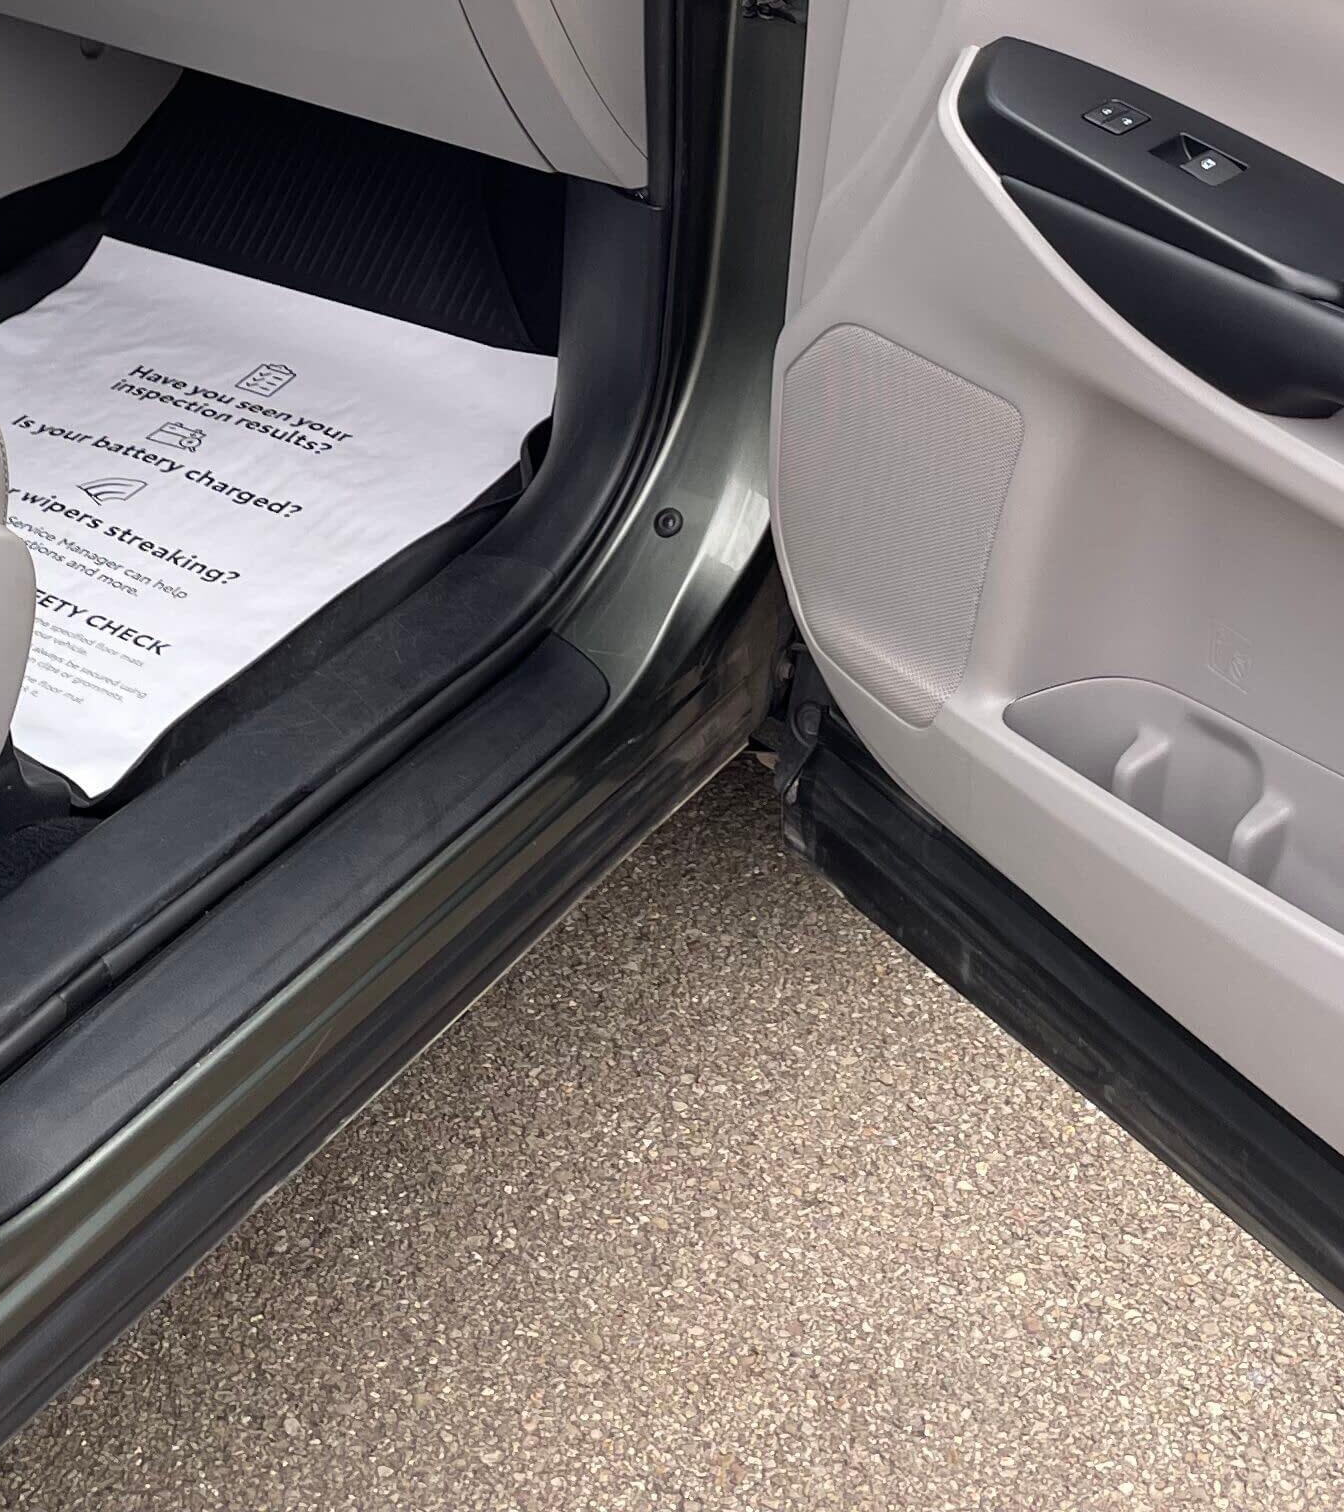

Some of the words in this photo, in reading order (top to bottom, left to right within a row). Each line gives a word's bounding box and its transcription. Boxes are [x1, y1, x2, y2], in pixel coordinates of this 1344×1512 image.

[110, 379, 234, 422] inspection
[235, 416, 333, 454] results?
[129, 364, 188, 390] Have
[185, 385, 235, 405] you
[235, 400, 293, 421] seen
[290, 416, 354, 441] your
[11, 415, 36, 429] Is
[31, 423, 94, 444] your
[92, 436, 184, 474] battery
[184, 469, 304, 518] charged?
[7, 515, 56, 542] Service
[57, 537, 125, 571] Manager
[123, 568, 153, 585] can
[152, 578, 189, 601] help
[21, 491, 104, 530] wipers
[103, 525, 241, 585] streaking?
[65, 558, 99, 577] and
[96, 571, 141, 597] more.
[85, 614, 173, 657] CHECK
